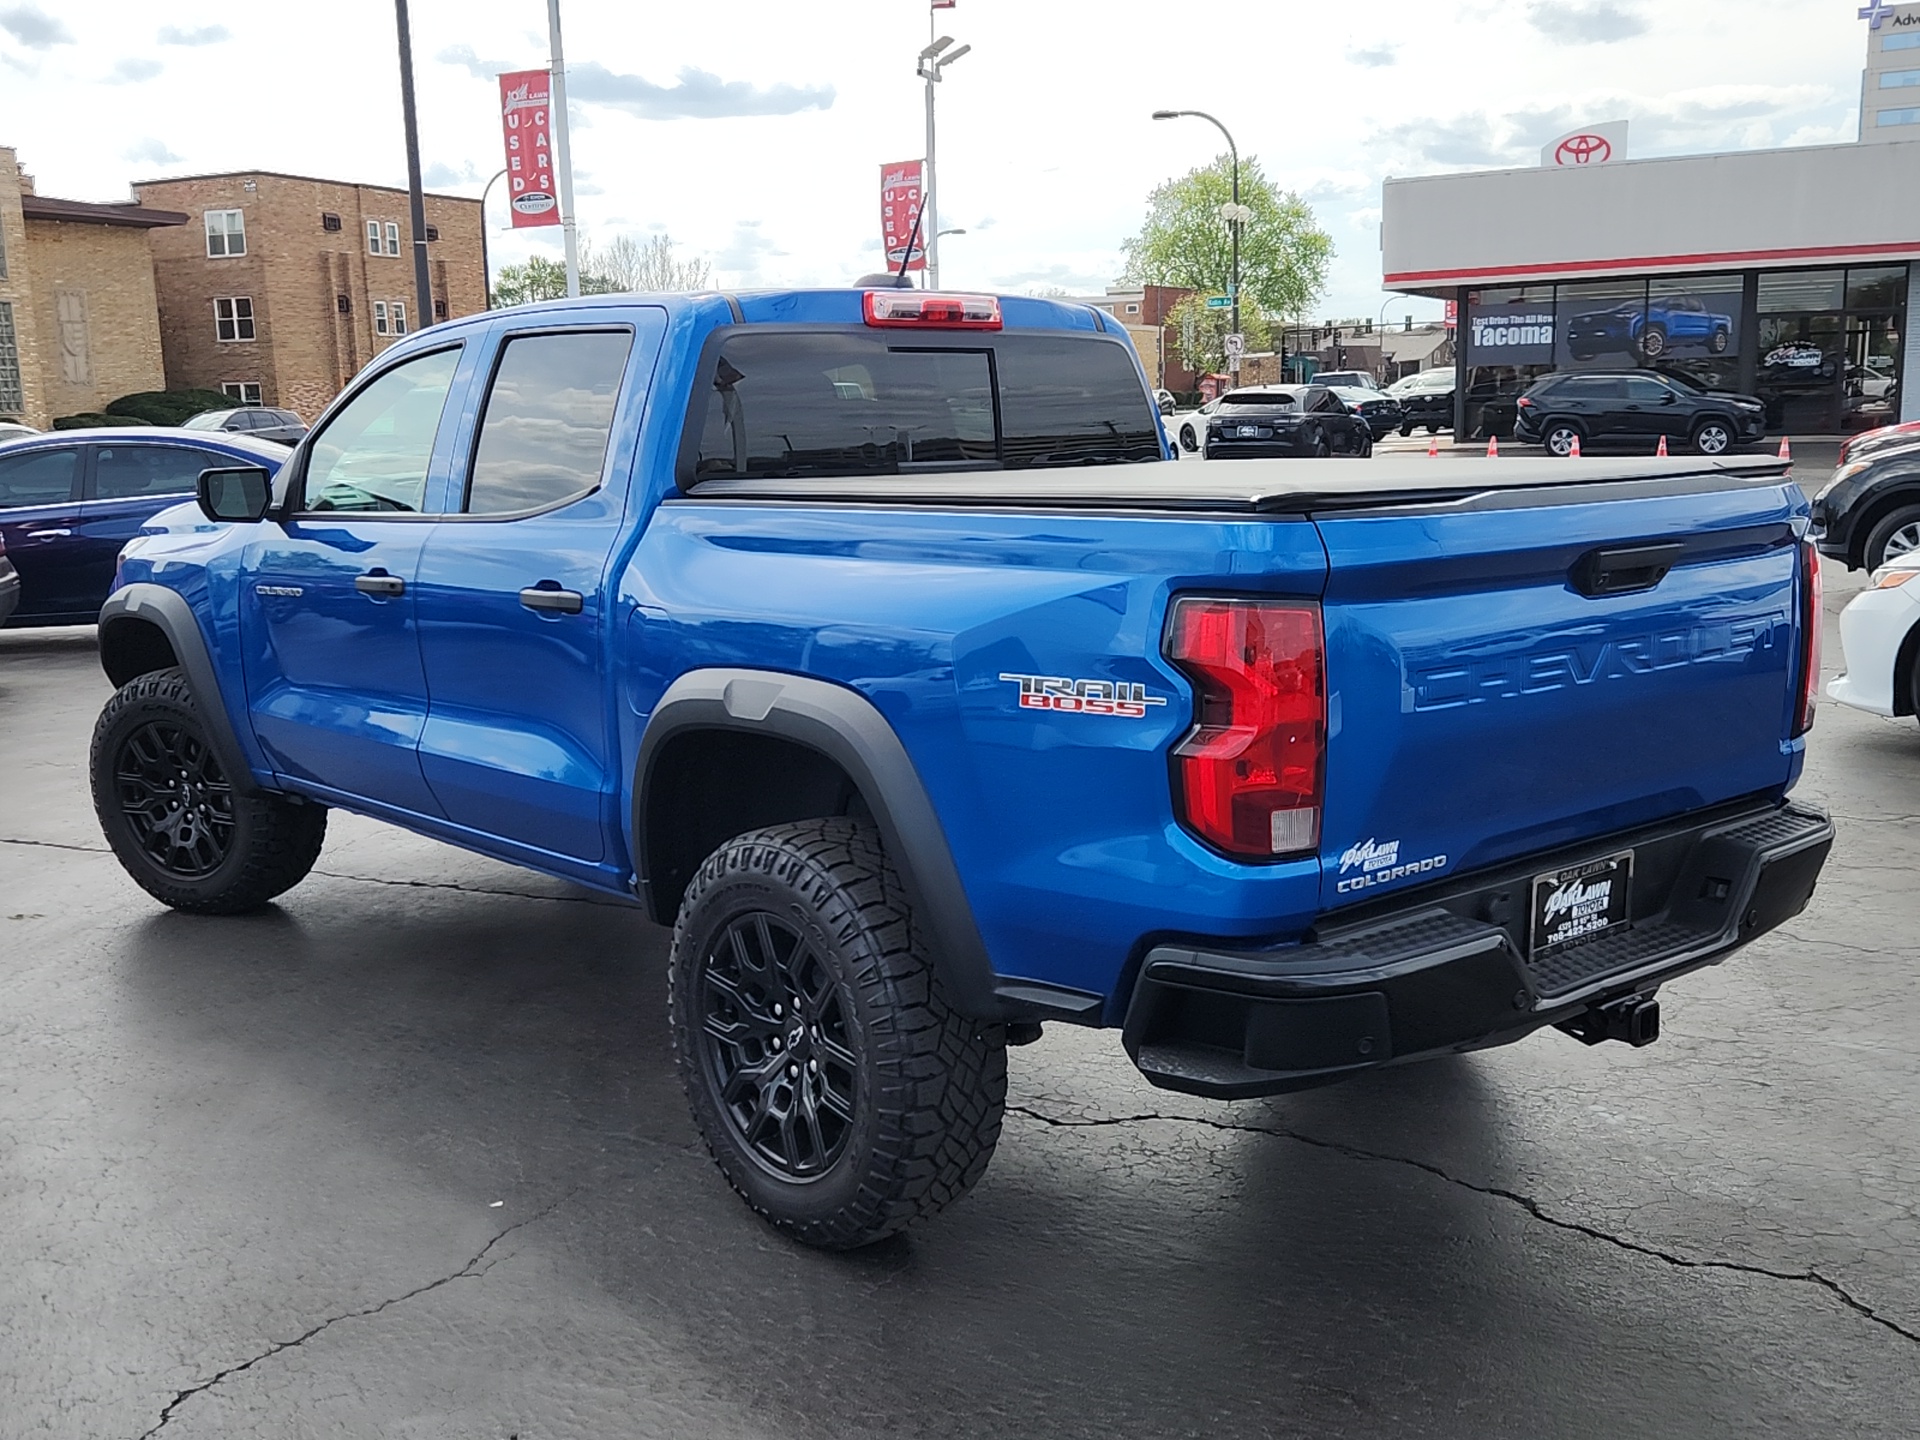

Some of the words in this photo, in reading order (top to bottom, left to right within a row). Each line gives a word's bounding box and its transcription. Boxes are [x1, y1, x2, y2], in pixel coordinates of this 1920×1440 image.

[507, 114, 525, 192] USED
[534, 111, 550, 190] CARS
[884, 190, 898, 247] USED
[1471, 326, 1553, 347] Tacoma
[1472, 317, 1488, 326] Test
[1488, 316, 1509, 325] Drive
[1509, 315, 1525, 324] The
[1525, 314, 1537, 324] All
[1414, 609, 1787, 713] CHEVROLET
[999, 672, 1167, 706] TRAIL
[1019, 693, 1146, 718] BOSS
[1337, 855, 1447, 893] COLORADO
[1576, 899, 1605, 915] TOYOTA
[1546, 916, 1609, 944] 708-423-5200
